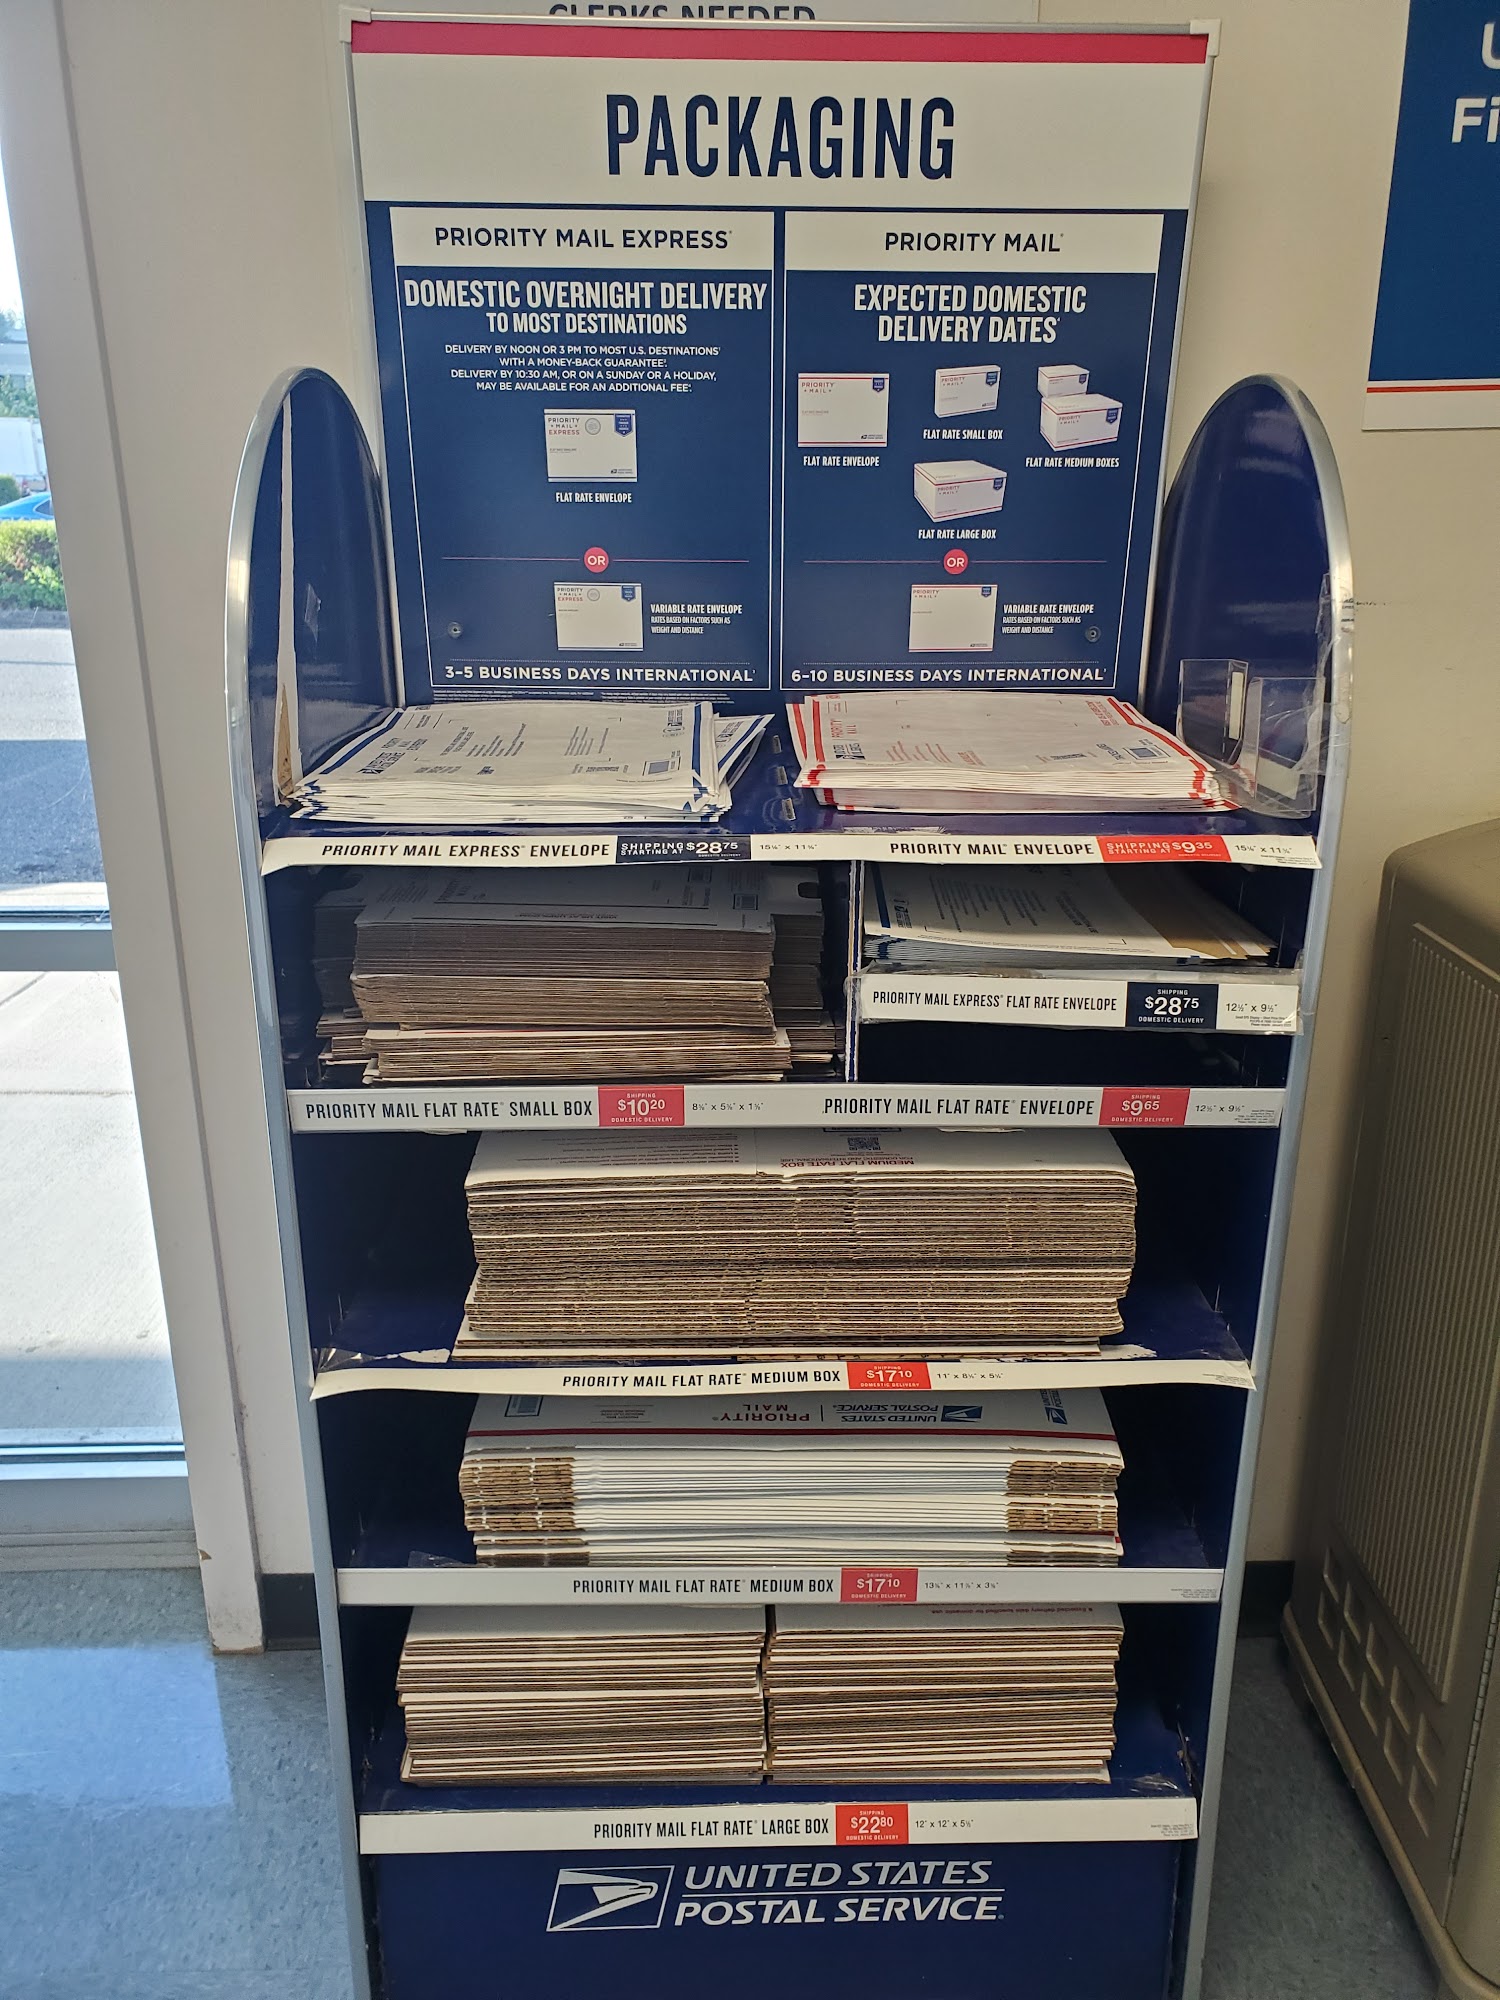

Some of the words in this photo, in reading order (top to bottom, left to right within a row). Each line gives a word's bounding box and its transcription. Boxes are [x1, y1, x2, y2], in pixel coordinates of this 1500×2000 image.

[607, 95, 954, 178] PACKAGING
[436, 228, 547, 246] PRIORITY
[557, 229, 614, 247] MAIL
[886, 233, 996, 251] PRIORITY
[404, 280, 520, 307] DOMESTIC
[526, 281, 654, 309] OVERNIGHT
[661, 283, 767, 310] DELIVERY
[855, 284, 966, 312] EXPECTED
[973, 285, 1086, 313] DOMESTIC
[486, 312, 508, 332] TO
[513, 312, 561, 333] MOST
[566, 313, 688, 334] DESTINATIONS
[879, 315, 984, 342] DELIVERY
[445, 345, 492, 353] DELIVERY
[495, 345, 507, 353] BY
[510, 345, 540, 354] NOON
[542, 345, 557, 354] OR
[559, 346, 565, 354] 3
[568, 346, 581, 354] PM
[584, 346, 597, 354] TO
[600, 346, 627, 354] MOST
[629, 346, 646, 355] U.S.
[499, 358, 525, 366] WITH
[528, 358, 535, 366] A
[537, 358, 602, 366] MONEY-BACK
[451, 369, 498, 378] DELIVERY
[500, 370, 513, 378] BY
[515, 370, 540, 378] 10:30
[542, 370, 560, 379] AM,
[562, 370, 576, 379] OR
[579, 371, 594, 379] ON
[596, 371, 603, 379] A
[606, 371, 645, 379] SUNDAY
[647, 371, 661, 379] OR
[664, 371, 671, 379] A
[674, 371, 716, 381] HOLIDAY,
[476, 382, 497, 390] MAY
[500, 382, 512, 390] BE
[515, 383, 567, 391] AVAILABLE
[569, 383, 589, 391] FOR
[592, 383, 606, 391] AN
[609, 383, 668, 391] ADDITIONAL
[923, 429, 940, 439] FLAT
[942, 429, 960, 439] RATE
[962, 430, 985, 439] SMALL
[988, 430, 1003, 439] BOX
[804, 456, 820, 466] FLAT
[823, 456, 840, 466] RATE
[843, 456, 879, 466] ENVELOPE
[556, 492, 572, 502] FLAT
[575, 493, 593, 502] RATE
[595, 493, 632, 502] ENVELOPE
[919, 530, 935, 539] FLAT
[937, 529, 955, 539] RATE
[956, 530, 980, 539] LARGE
[981, 530, 996, 539] BOX
[588, 556, 605, 565] OR
[947, 558, 964, 567] OR
[651, 604, 685, 613] VARIABLE
[687, 605, 705, 613] RATE
[707, 605, 742, 614] ENVELOPE
[445, 666, 473, 678] 3-5
[479, 667, 561, 679] BUSINESS
[568, 668, 610, 680] DAYS
[792, 670, 827, 681] 6-10
[834, 670, 914, 681] BUSINESS
[920, 670, 962, 681] DAYS
[322, 845, 398, 855] PRIORITY
[403, 846, 441, 856] MAIL
[531, 845, 609, 856] ENVELOPE
[891, 844, 961, 854] PRIORITY
[1014, 844, 1093, 854] ENVELOPE
[874, 992, 921, 1004] PRIORITY
[925, 993, 949, 1005] MAIL
[1007, 996, 1030, 1008] FLAT
[1034, 997, 1059, 1009] RATE
[1063, 998, 1117, 1010] ENVELOPE
[306, 1104, 375, 1118] PRIORITY
[382, 1103, 419, 1117] MAIL
[424, 1103, 457, 1117] FLAT
[510, 1102, 558, 1116] SMALL
[564, 1101, 592, 1115] BOX
[825, 1099, 891, 1113] PRIORITY
[897, 1099, 931, 1113] MAIL
[938, 1099, 970, 1114] FLAT
[1020, 1100, 1094, 1114] ENVELOPE
[563, 1377, 628, 1386] PRIORITY
[634, 1376, 666, 1386] MAIL
[673, 1375, 703, 1386] FLAT
[752, 1372, 808, 1383] MEDIUM
[814, 1371, 840, 1381] BOX
[574, 1580, 634, 1592] PRIORITY
[640, 1580, 670, 1592] MAIL
[676, 1580, 705, 1592] FLAT
[751, 1580, 803, 1592] MEDIUM
[809, 1580, 833, 1592] BOX
[595, 1823, 651, 1838] PRIORITY
[657, 1822, 686, 1837] MAIL
[692, 1821, 719, 1836] FLAT
[762, 1819, 800, 1834] LARGE
[806, 1819, 828, 1833] BOX
[685, 1863, 841, 1888] UNITED
[848, 1861, 992, 1886] STATES
[675, 1899, 825, 1925] POSTAL
